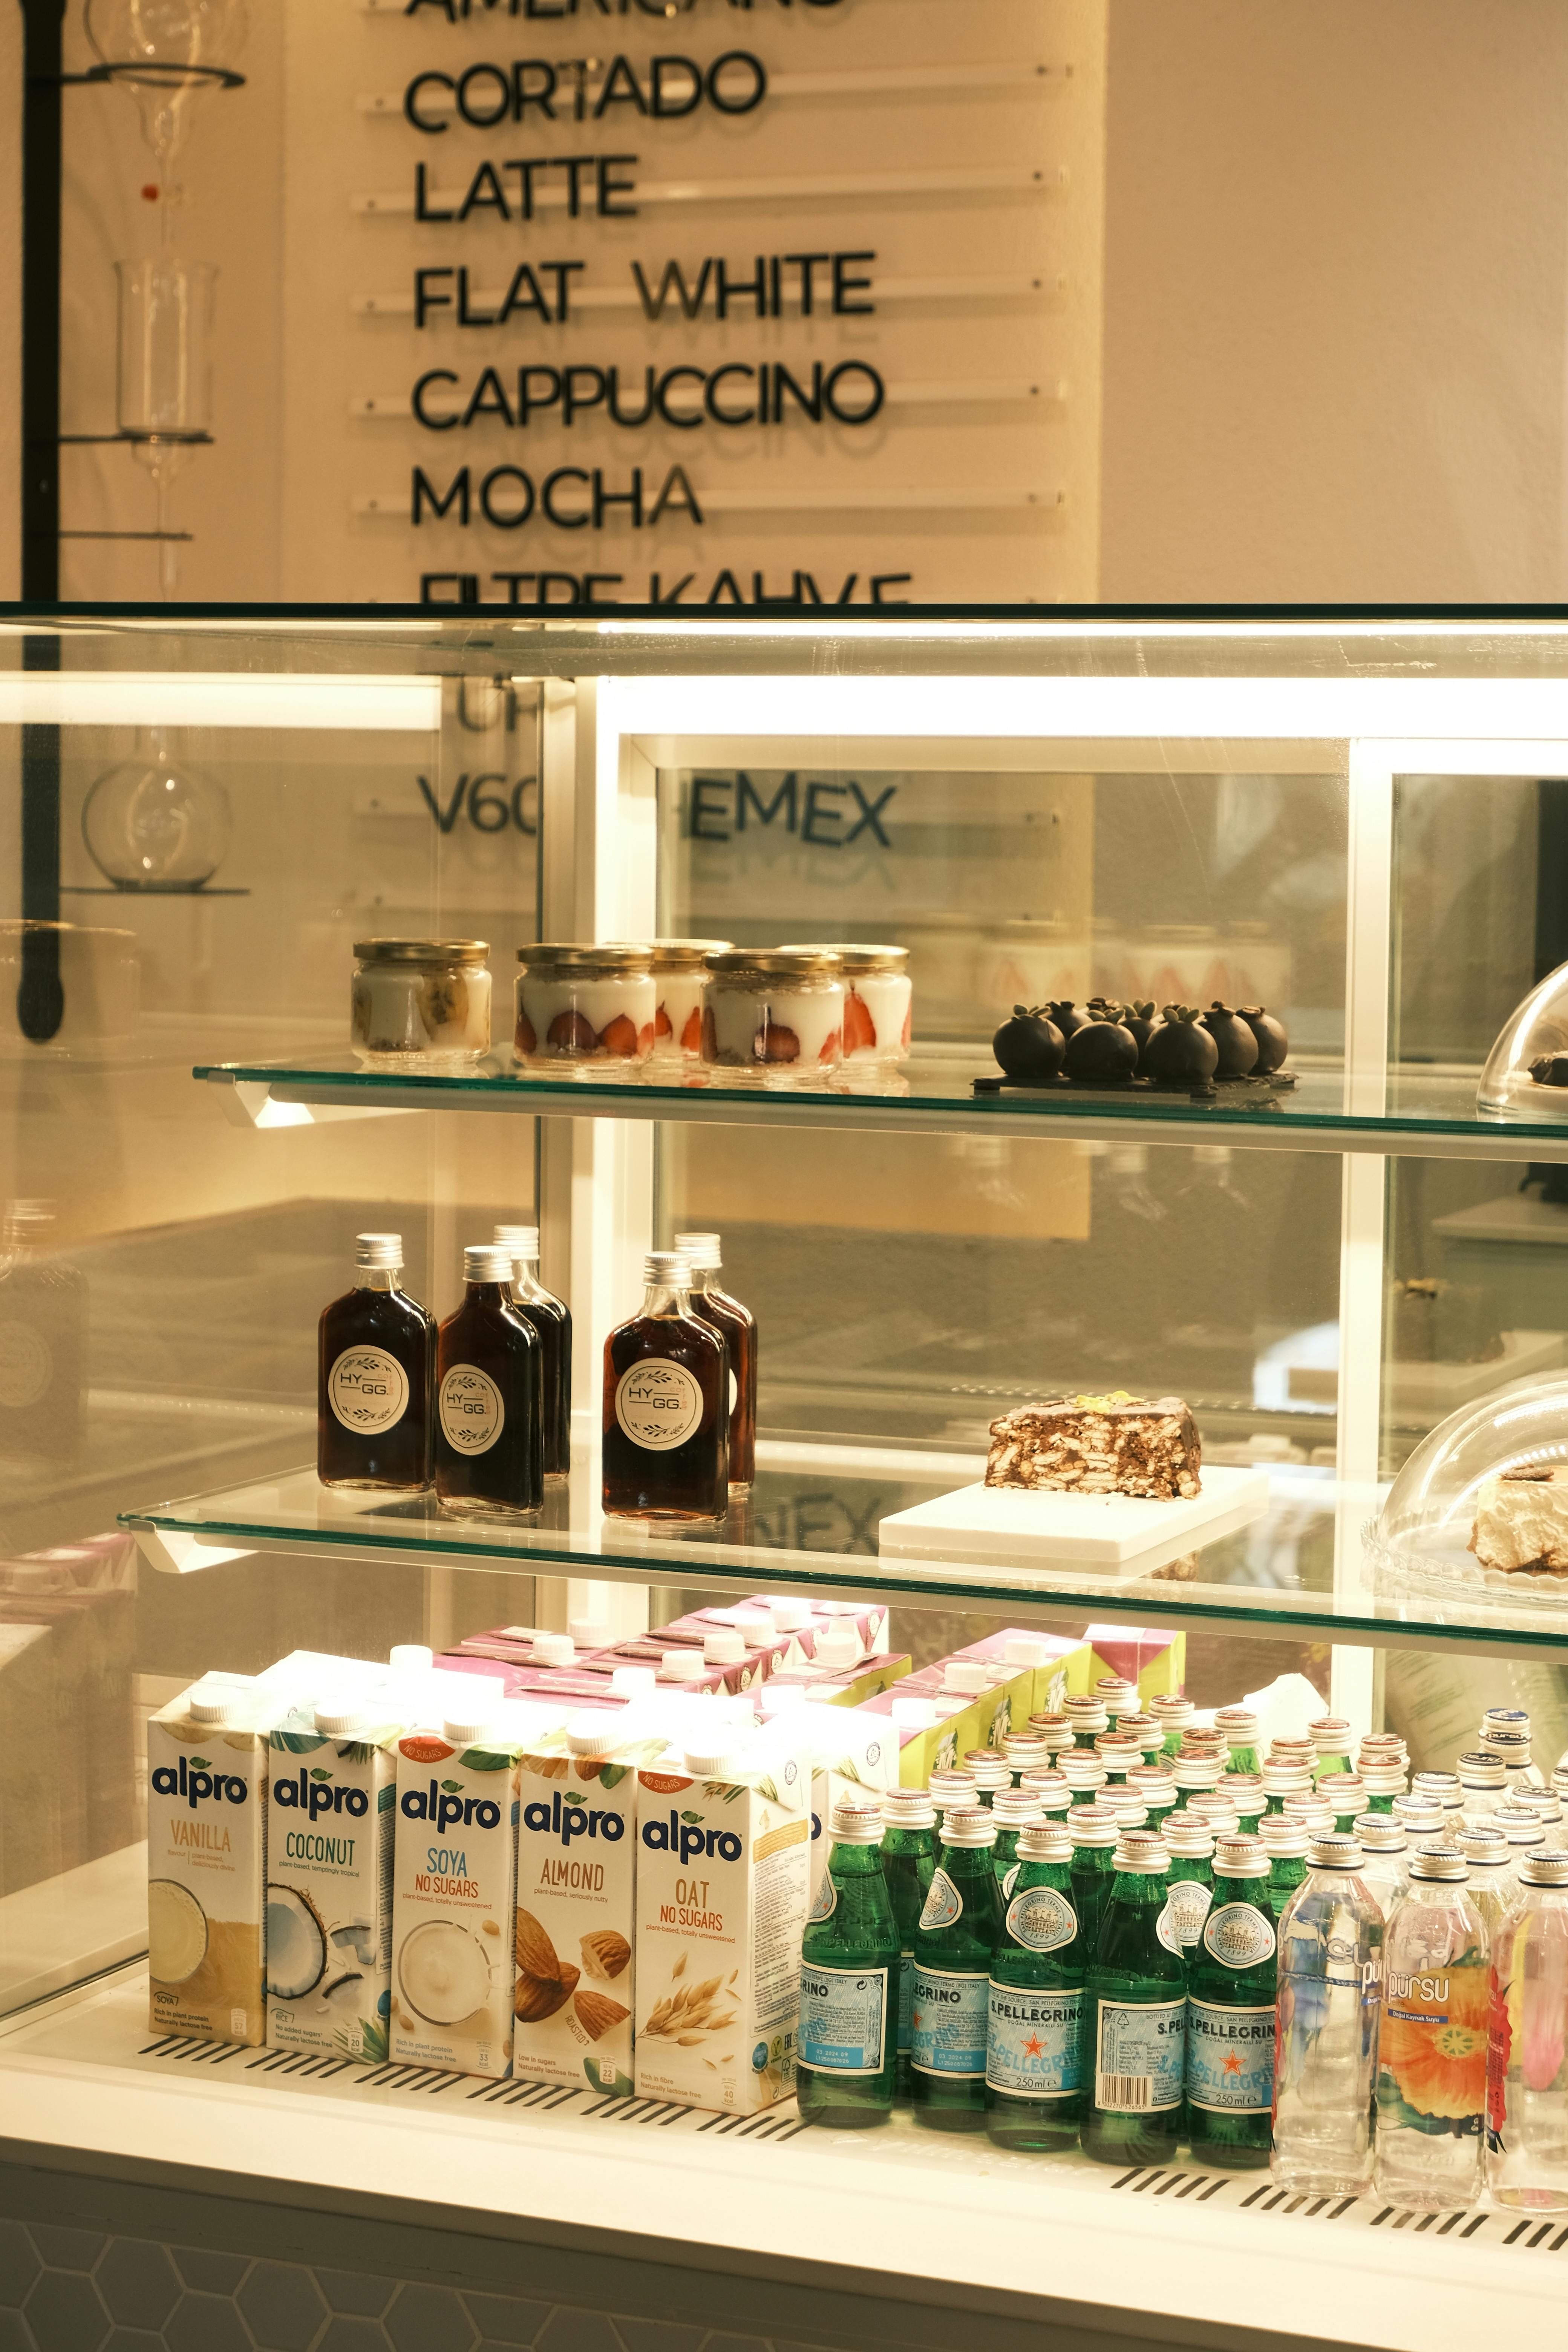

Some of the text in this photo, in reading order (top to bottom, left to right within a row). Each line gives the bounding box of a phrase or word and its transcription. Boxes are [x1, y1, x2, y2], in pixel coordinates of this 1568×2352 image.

[403, 51, 766, 133] CORTADO
[415, 156, 639, 223] LATTE
[415, 251, 876, 328] FLAT WHITE
[410, 360, 886, 430] CAPPUCCINO
[411, 464, 704, 528] MOCHA
[340, 1373, 362, 1384] HY
[447, 1393, 463, 1403] HY
[629, 1387, 653, 1398] HY
[404, 1744, 442, 1759] NO SUGARS
[152, 1756, 247, 1808] alpro
[643, 1774, 680, 1791] NO SUGARS
[274, 1768, 368, 1821] alpro
[401, 1779, 501, 1834] alpro
[524, 1791, 625, 1846] alpro
[170, 1819, 231, 1852] VANILLA
[642, 1810, 742, 1865] alpro
[286, 1832, 355, 1866] COCONUT
[191, 1860, 219, 1870] deliciously
[279, 1860, 360, 1877] plant-based, temptingly tropical
[427, 1847, 467, 1877] SOYA
[540, 1858, 604, 1891] ALMOND
[415, 1874, 478, 1899] NO SUGARS
[675, 1878, 709, 1909] OAT
[403, 1893, 492, 1910] plant-based, totally unsweetened
[534, 1888, 608, 1903] plant-based, seriously nutty
[1020, 1897, 1045, 1919] PELLEGRINO
[1048, 1899, 1061, 1914] TERME
[660, 1905, 723, 1931] NO SUGARS
[1218, 1913, 1242, 1935] PELLEGRINO
[1245, 1915, 1258, 1929] TERME
[646, 1924, 735, 1943] plant-based, totally unsweetened
[1249, 1938, 1260, 1953] ITALIA
[1388, 1971, 1449, 2003] pürsu
[157, 1995, 175, 2005] SOYA
[188, 2014, 209, 2022] protein
[276, 2014, 288, 2023] RICE
[991, 2000, 1083, 2022] S.PELLEGRINO
[1393, 2011, 1405, 2019] Doğal
[155, 2017, 178, 2026] Naturally
[179, 2019, 200, 2029] lactose
[285, 2025, 302, 2035] added
[565, 2015, 585, 2045] ROASTED
[1190, 2016, 1276, 2039] S.PELLEGRIN
[275, 2033, 299, 2043] Naturally
[300, 2036, 320, 2046] lactose
[415, 2042, 430, 2051] plant
[432, 2044, 453, 2053] protein
[396, 2047, 421, 2058] Naturally
[422, 2051, 443, 2061] lactose
[537, 2058, 556, 2066] sugars
[518, 2063, 544, 2073] Naturally
[545, 2067, 567, 2076] lactose
[641, 2072, 652, 2081] Rich
[641, 2082, 666, 2092] Naturally
[667, 2086, 688, 2096] lactose
[1017, 2077, 1045, 2088] 250 ml
[1216, 2094, 1245, 2105] 250 ml
